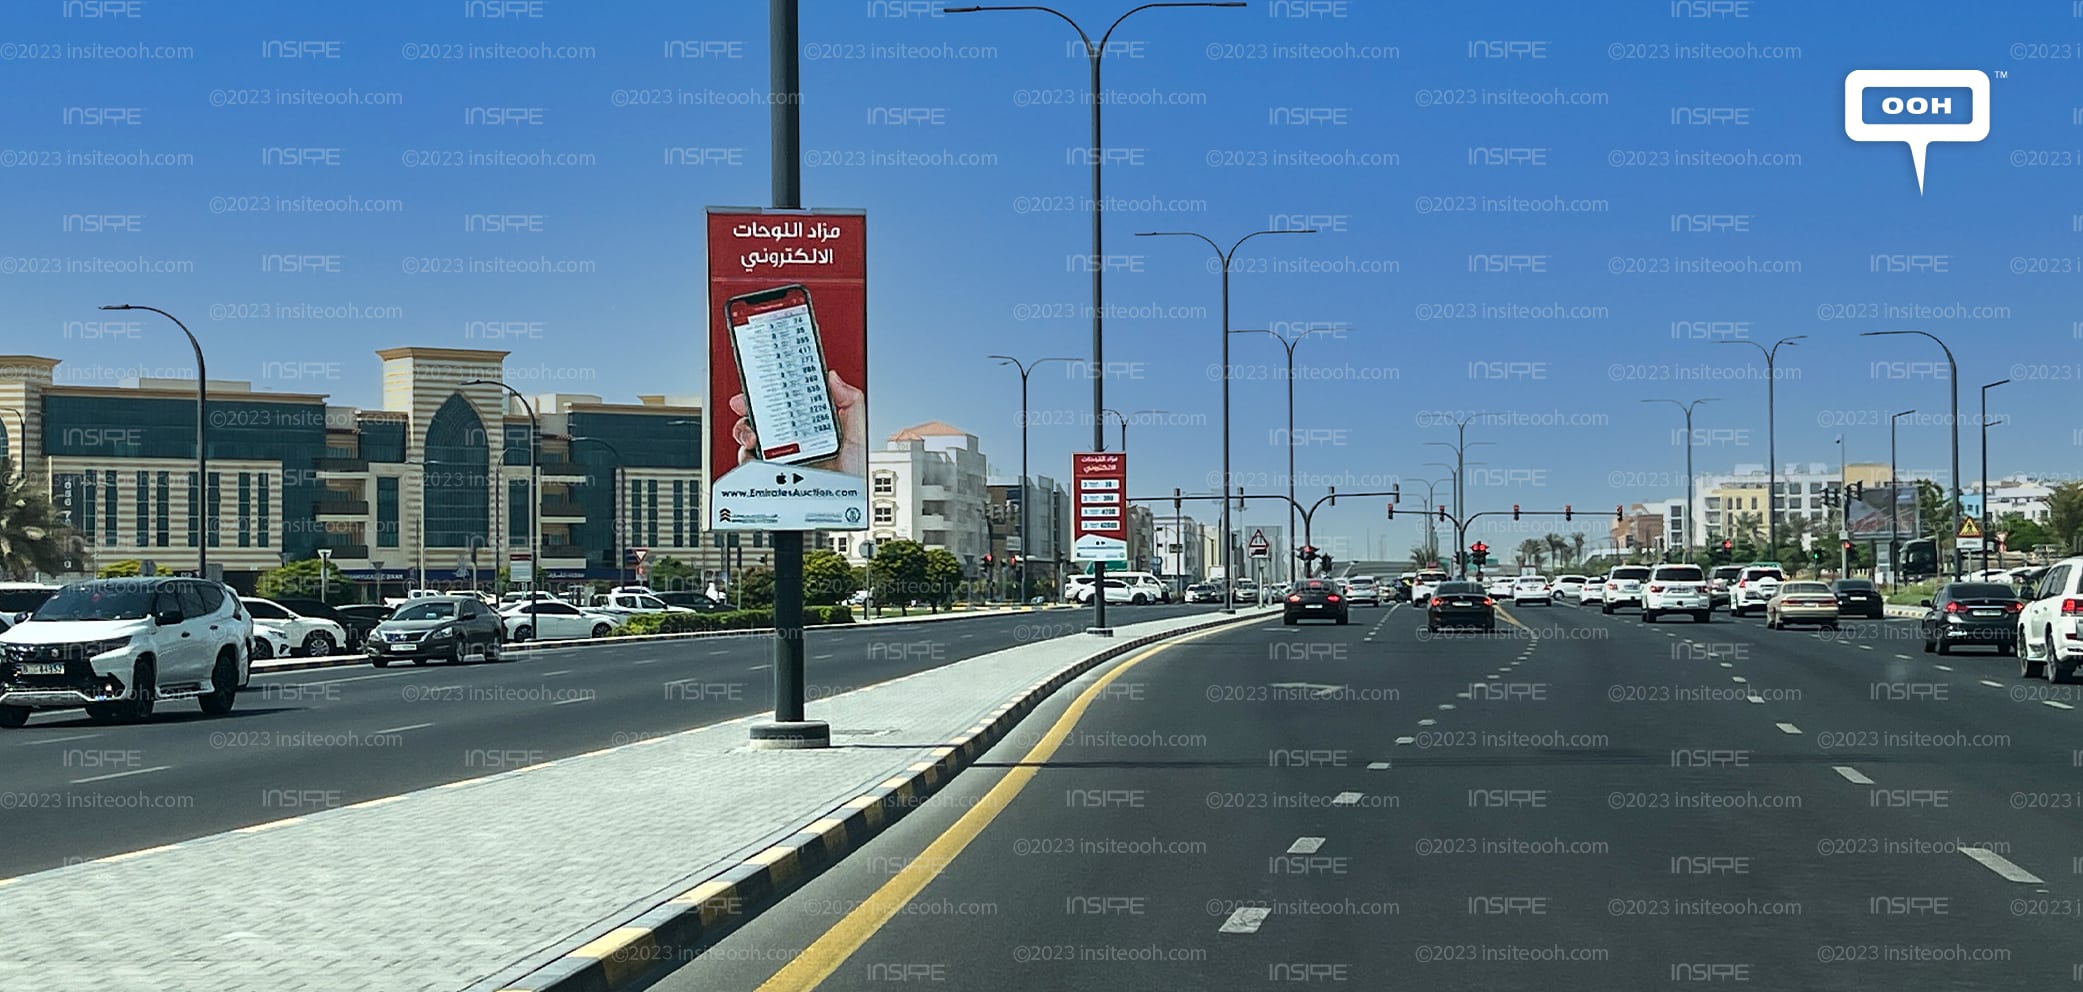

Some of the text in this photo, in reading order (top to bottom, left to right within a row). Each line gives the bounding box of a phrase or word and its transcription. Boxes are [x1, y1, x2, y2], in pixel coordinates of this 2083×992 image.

[733, 222, 841, 243] مزاد اللوحات
[741, 248, 833, 272] الالكتروني
